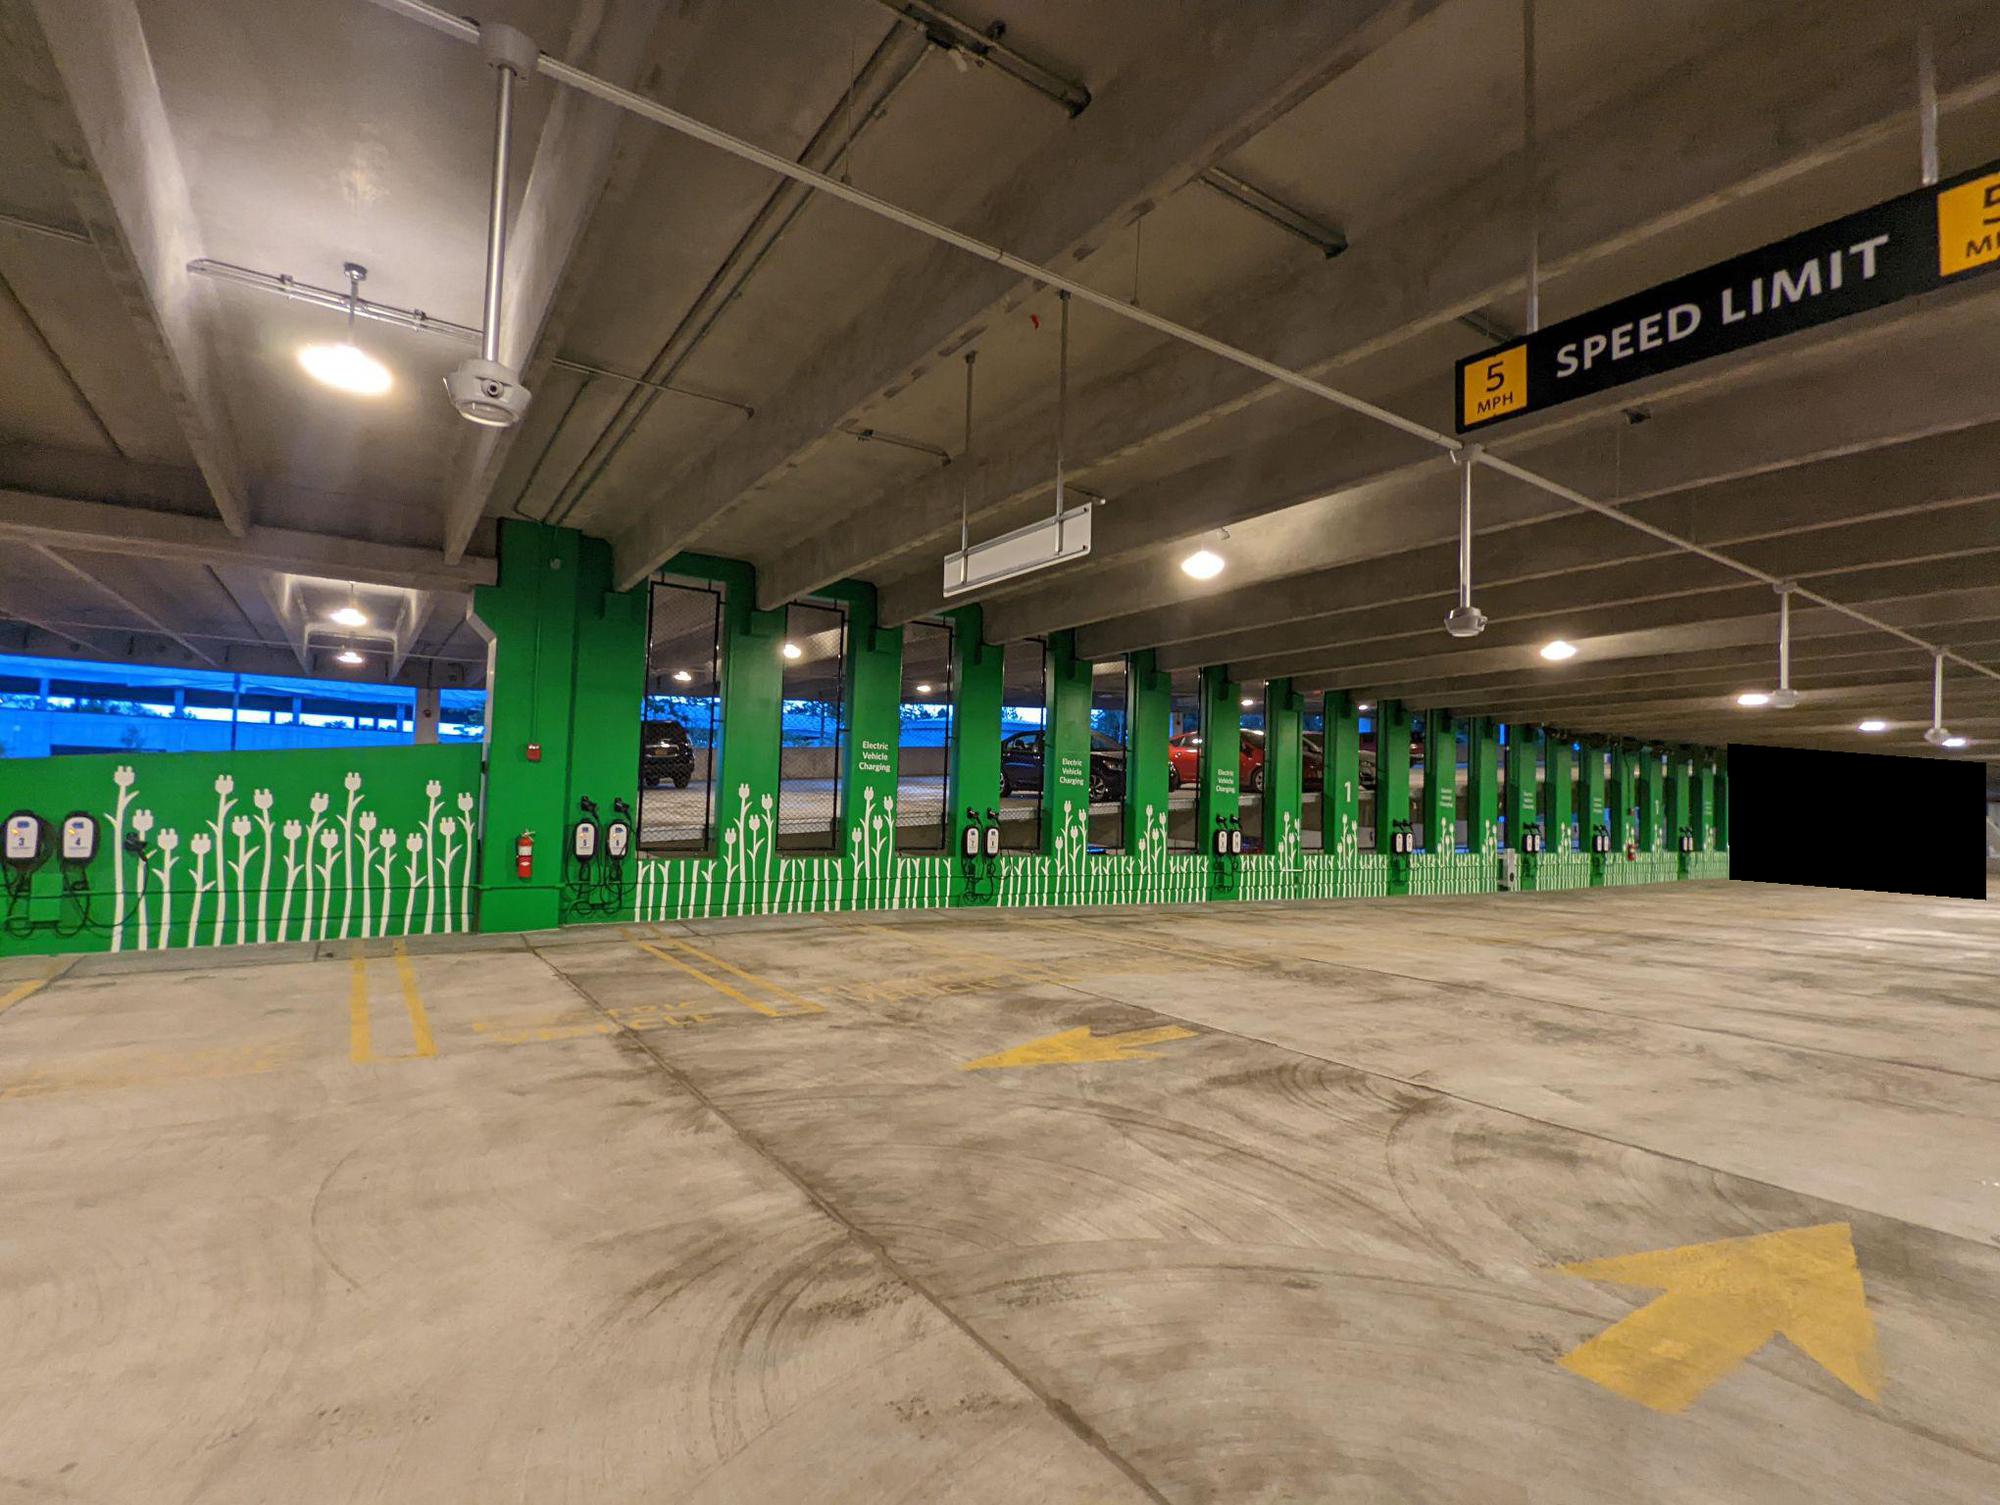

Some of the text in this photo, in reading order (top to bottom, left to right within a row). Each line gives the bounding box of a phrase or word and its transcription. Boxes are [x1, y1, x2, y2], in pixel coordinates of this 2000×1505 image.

[1556, 234, 1889, 378] SPEED LIMIT
[1486, 361, 1504, 392] 5
[1477, 392, 1514, 415] MPH
[862, 740, 889, 750] Electric
[862, 751, 888, 760] Vehicle
[858, 761, 891, 773] Charging
[1062, 757, 1082, 766] Electric
[1062, 767, 1082, 775] Vehicle
[1059, 776, 1084, 786] Charging
[1344, 781, 1351, 803] 1
